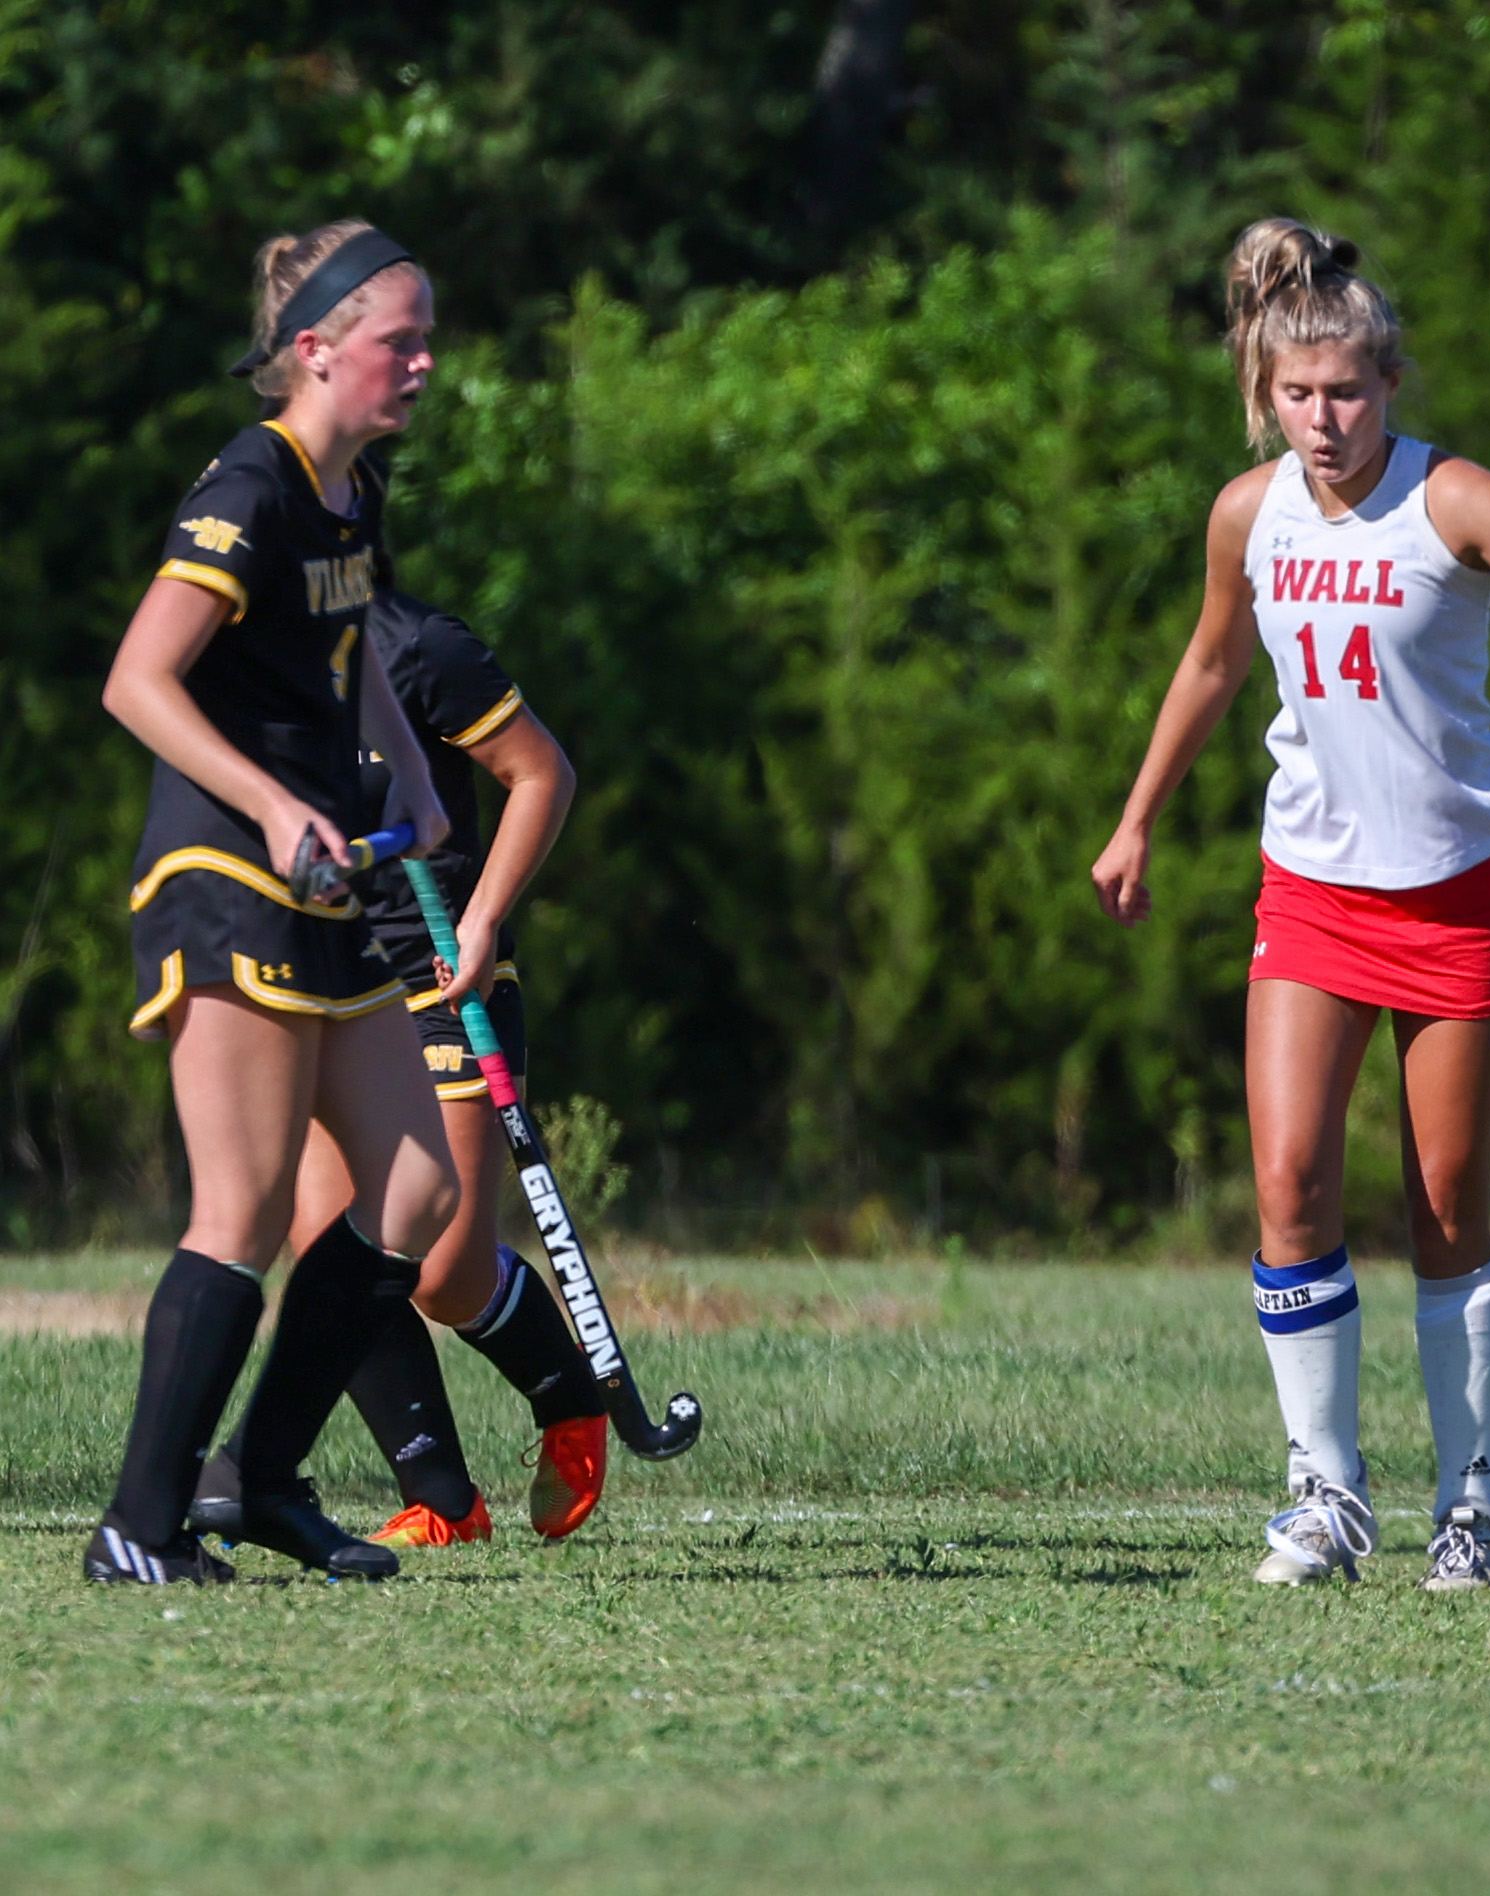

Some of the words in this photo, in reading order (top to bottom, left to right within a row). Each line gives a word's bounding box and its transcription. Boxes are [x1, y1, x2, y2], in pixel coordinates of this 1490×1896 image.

[1273, 558, 1404, 607] WALL
[1295, 622, 1380, 701] 14
[519, 1163, 622, 1377] GRYPHON
